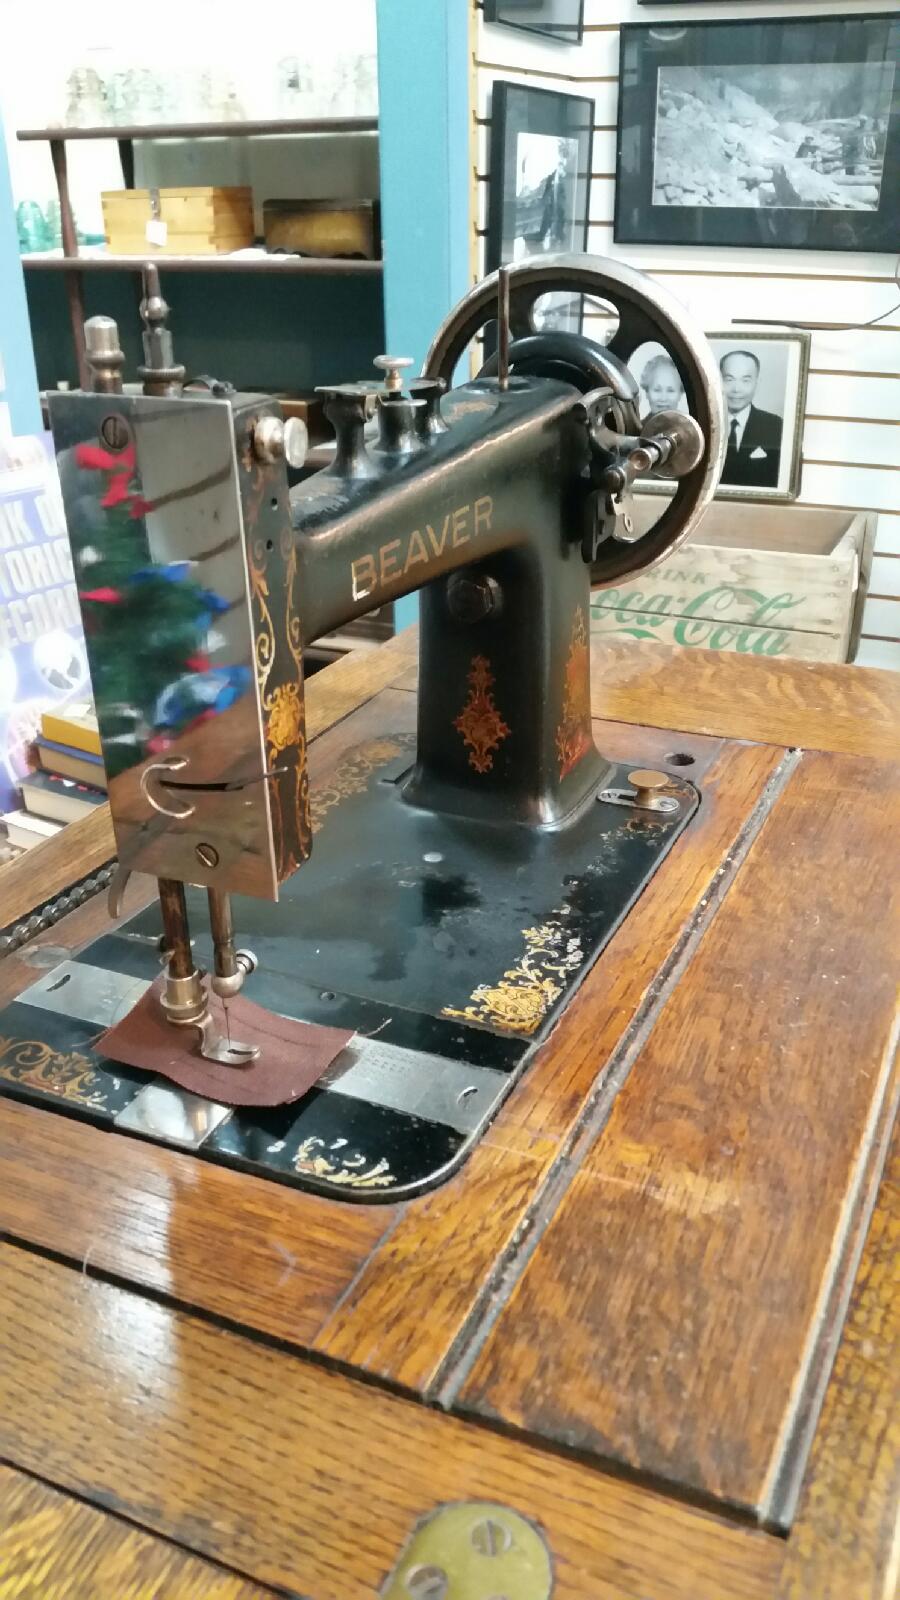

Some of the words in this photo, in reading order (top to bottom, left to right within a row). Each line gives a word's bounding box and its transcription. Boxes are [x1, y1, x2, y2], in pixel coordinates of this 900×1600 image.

[351, 495, 494, 602] BEAVER
[645, 567, 711, 585] RINK
[591, 585, 807, 655] oca-Cola
